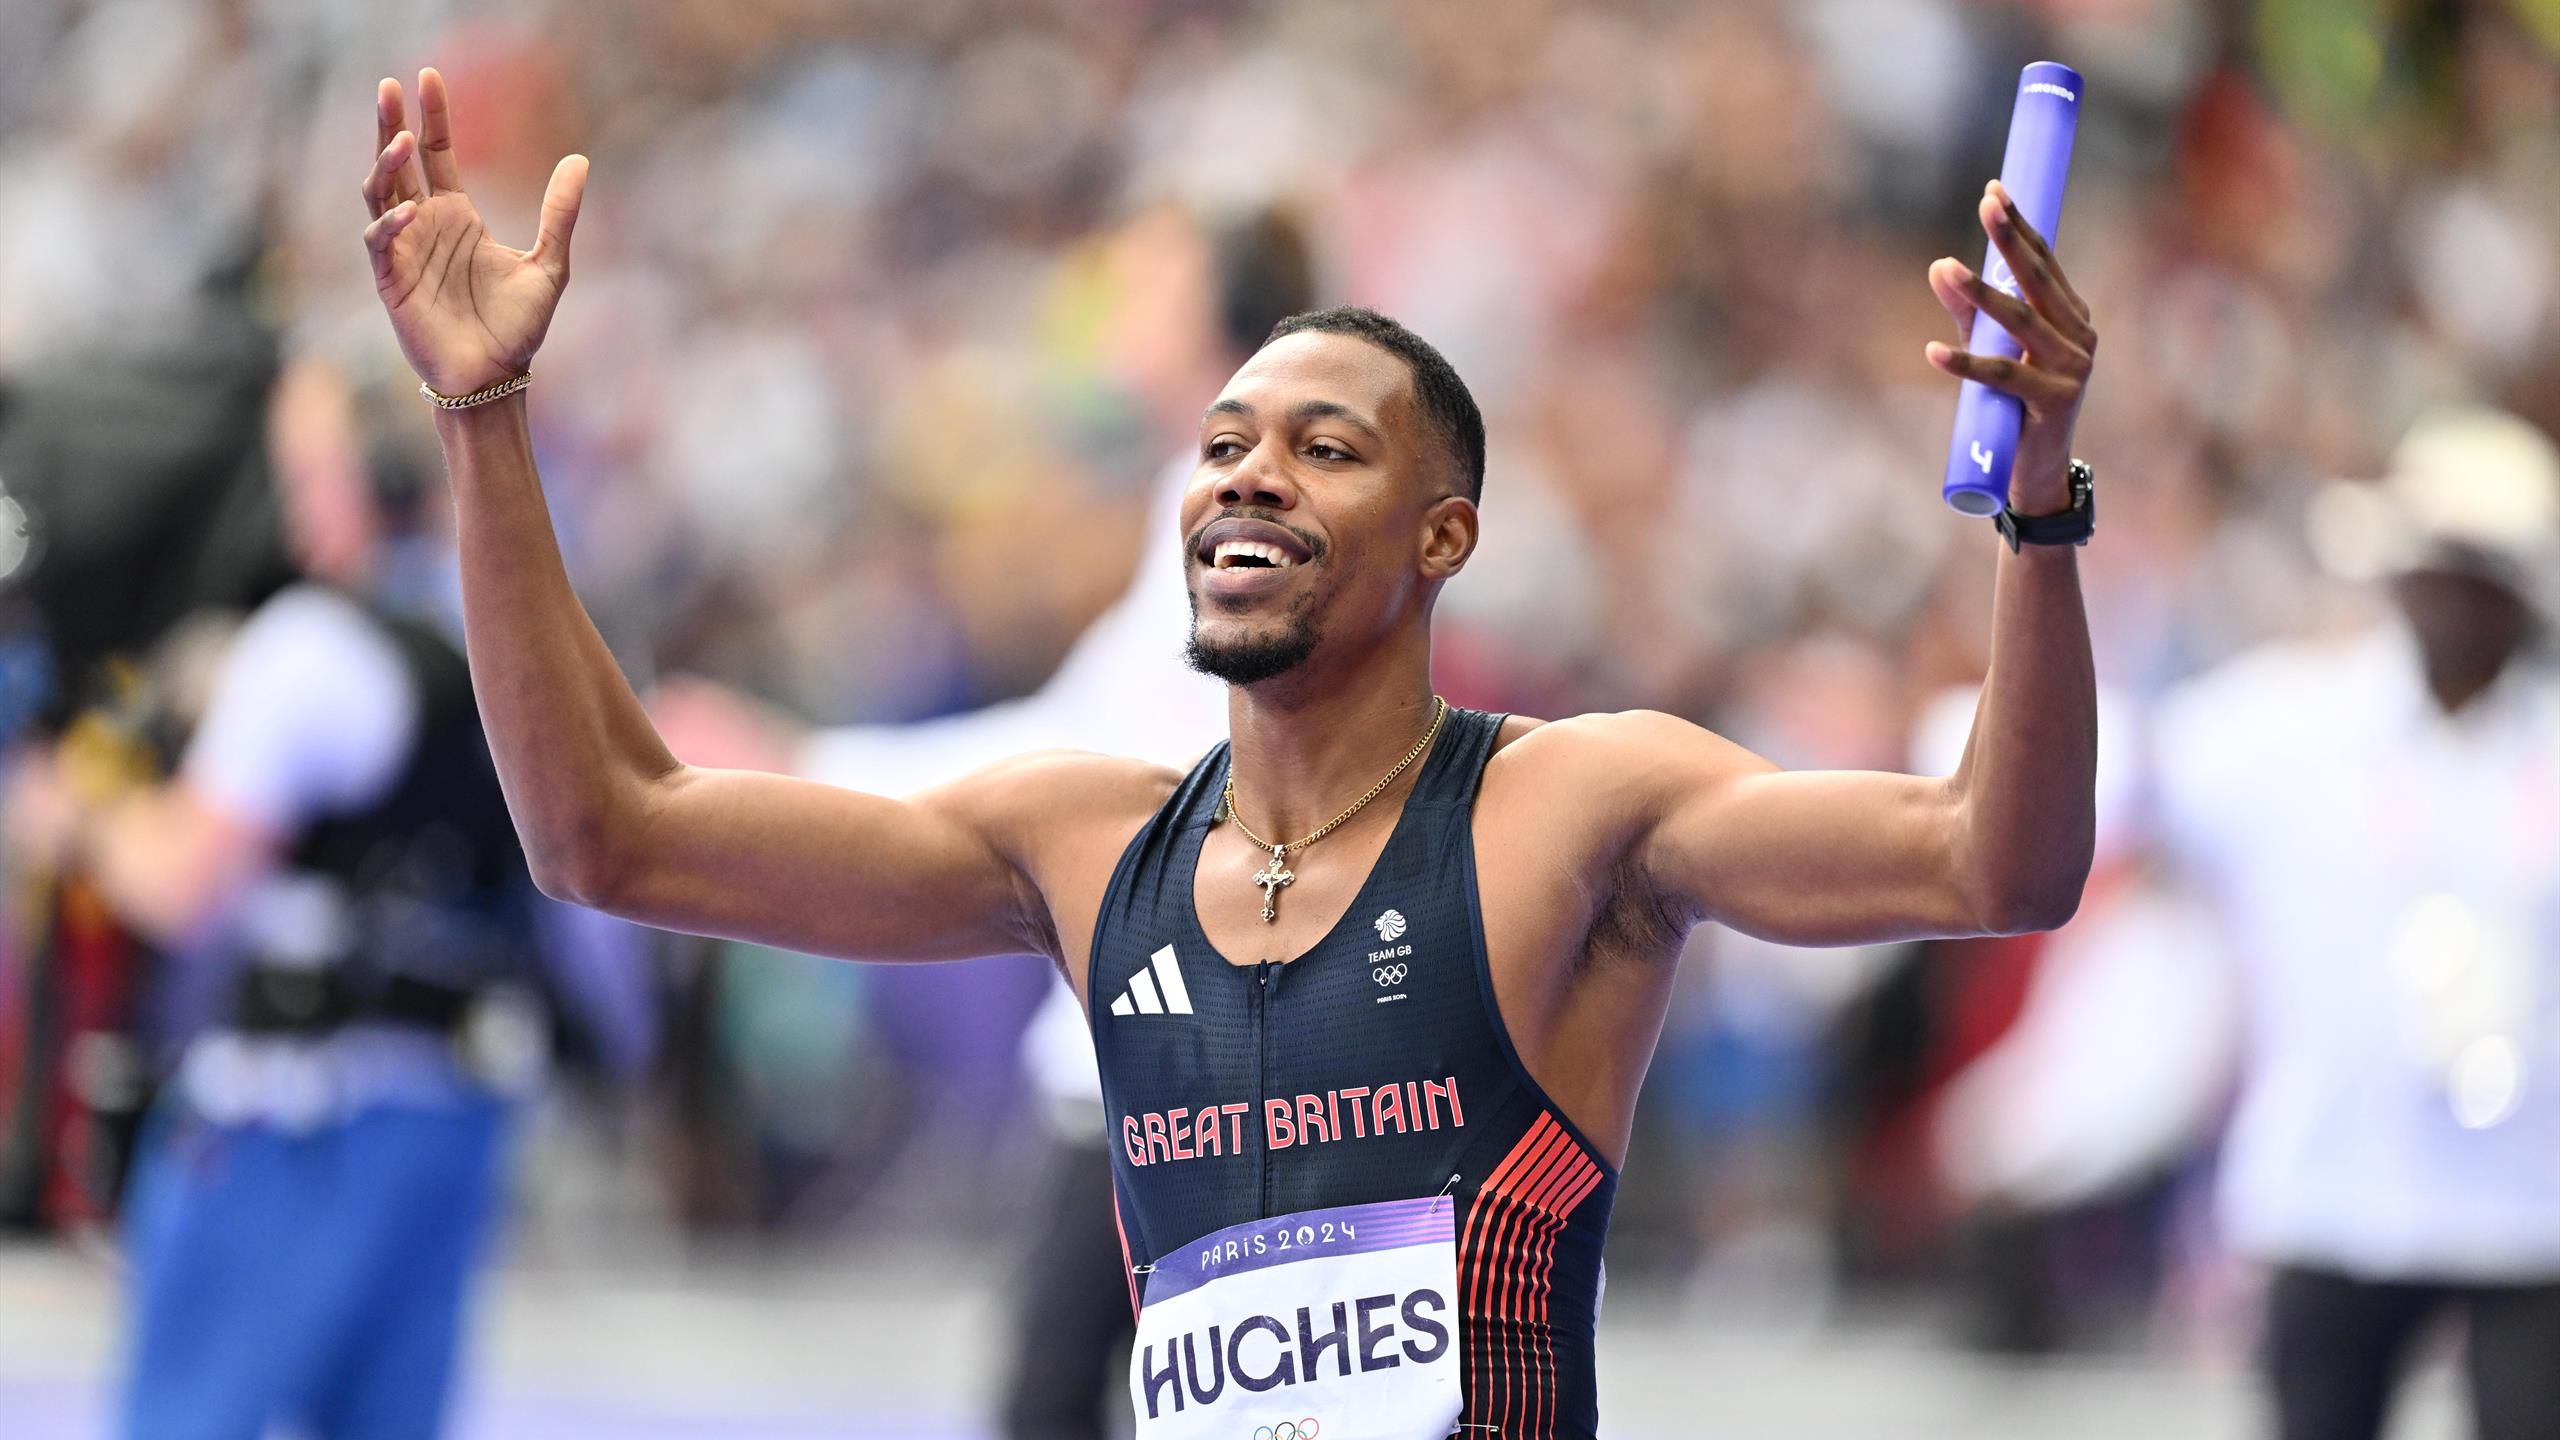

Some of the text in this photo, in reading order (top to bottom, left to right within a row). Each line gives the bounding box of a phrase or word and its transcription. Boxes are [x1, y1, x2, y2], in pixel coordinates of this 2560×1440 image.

[1970, 440, 1993, 474] 4
[1368, 945, 1412, 963] TEAM GB
[1123, 1076, 1465, 1168] GREAT BRITAIN
[1277, 1221, 1356, 1251] 2024
[1142, 1288, 1451, 1420] HUGHES
